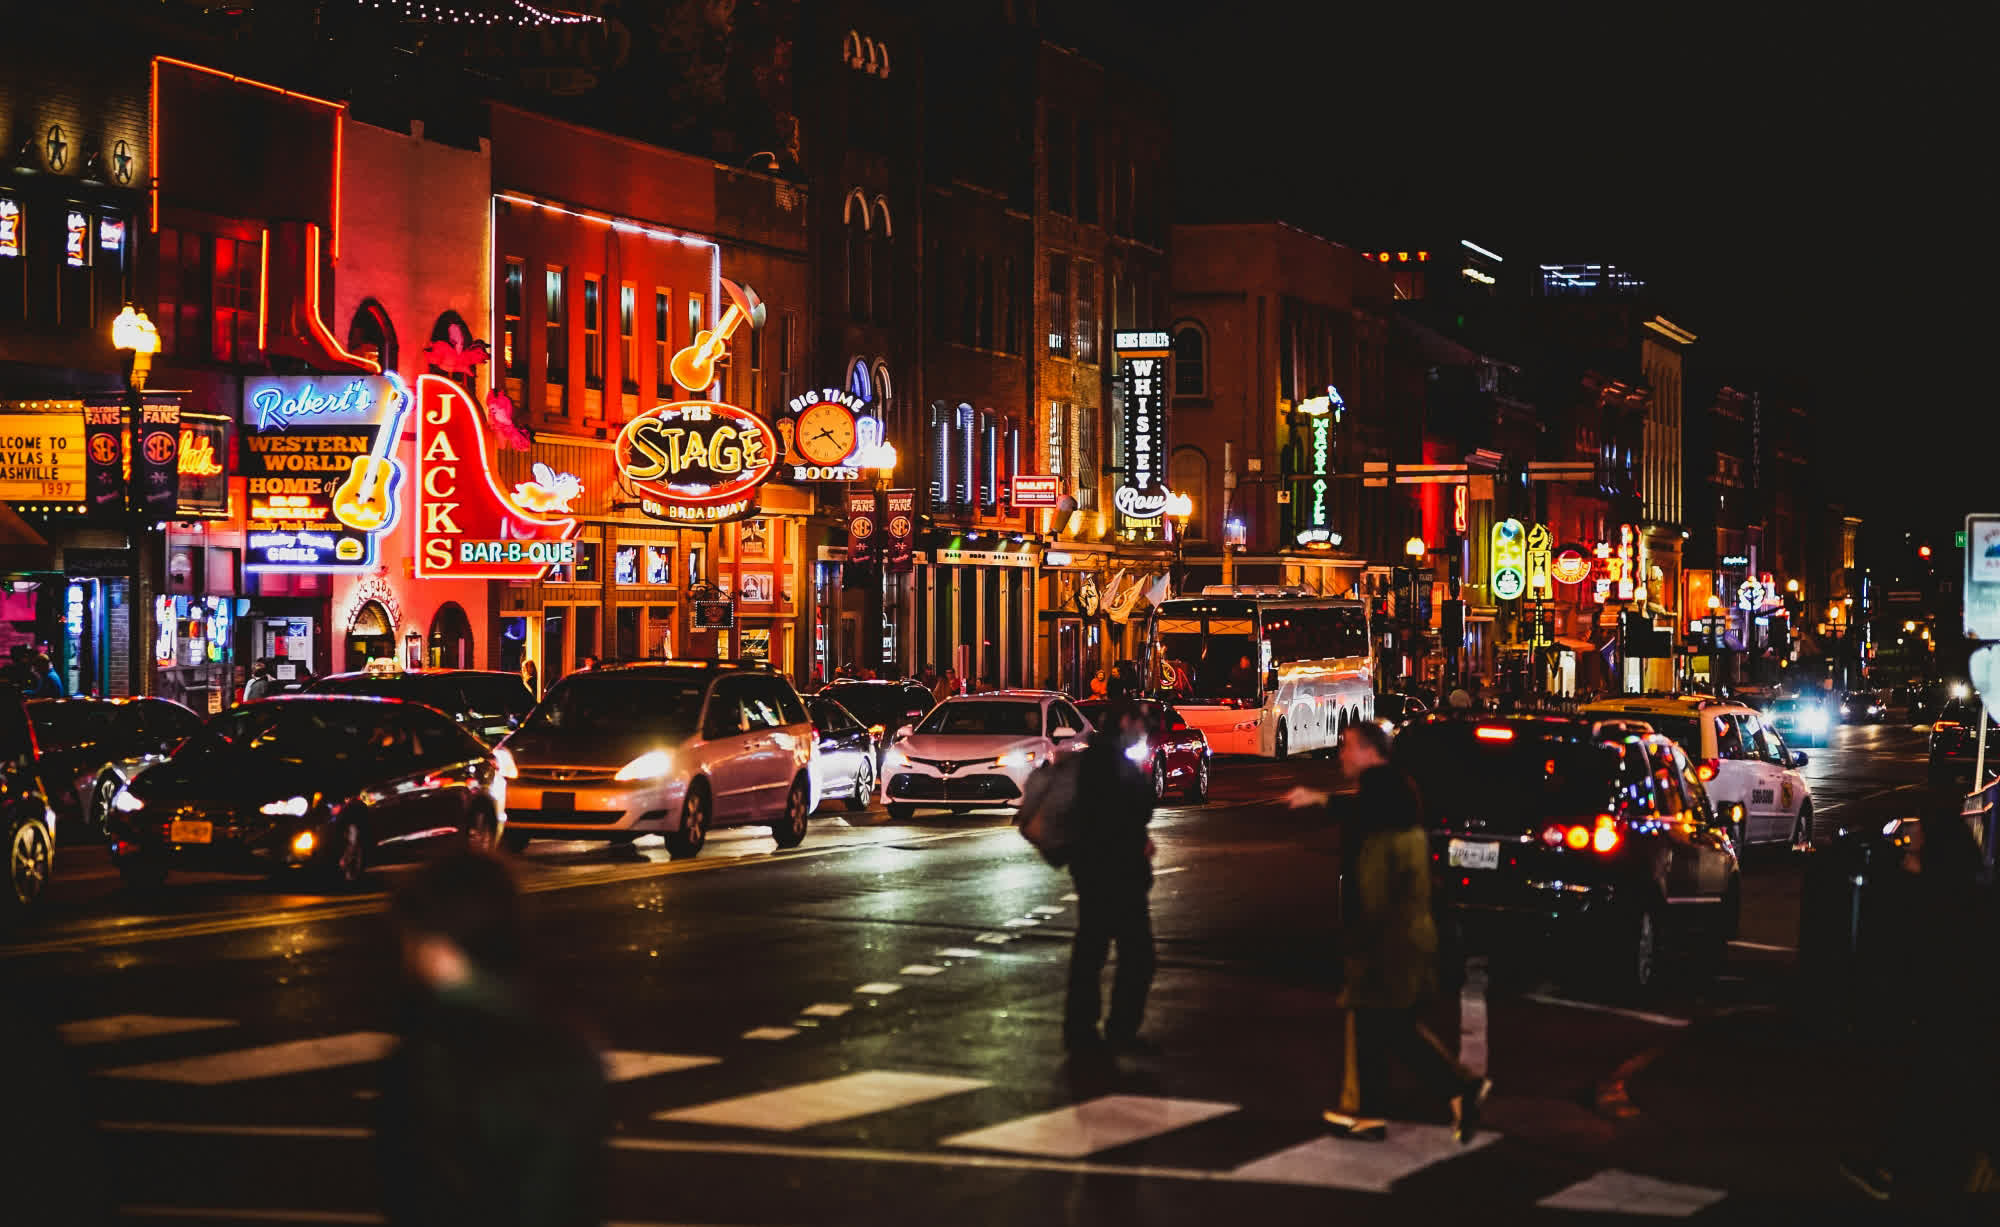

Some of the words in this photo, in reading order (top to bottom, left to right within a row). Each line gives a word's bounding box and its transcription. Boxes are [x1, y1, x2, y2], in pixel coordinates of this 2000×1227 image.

[253, 380, 377, 433] Robert's
[789, 390, 820, 413] BIG
[822, 388, 865, 413] TIME
[86, 413, 120, 425] FANS
[143, 411, 180, 424] FANS
[681, 406, 712, 421] THE
[1131, 360, 1154, 489] WHISKEY
[49, 436, 67, 449] TO
[248, 436, 369, 453] WESTERN
[625, 417, 770, 481] STAGE
[264, 455, 352, 471] WORLD
[423, 393, 463, 569] JACKS
[793, 466, 859, 480] BOOTS
[41, 482, 71, 496] 1997
[249, 477, 321, 494] HOME
[324, 477, 340, 498] of
[1120, 487, 1165, 510] Row
[642, 499, 661, 516] ON
[669, 499, 748, 519] BROADWAY
[851, 504, 875, 512] FANS
[889, 503, 912, 512] FANS
[461, 542, 575, 563] BAR-B-QUE
